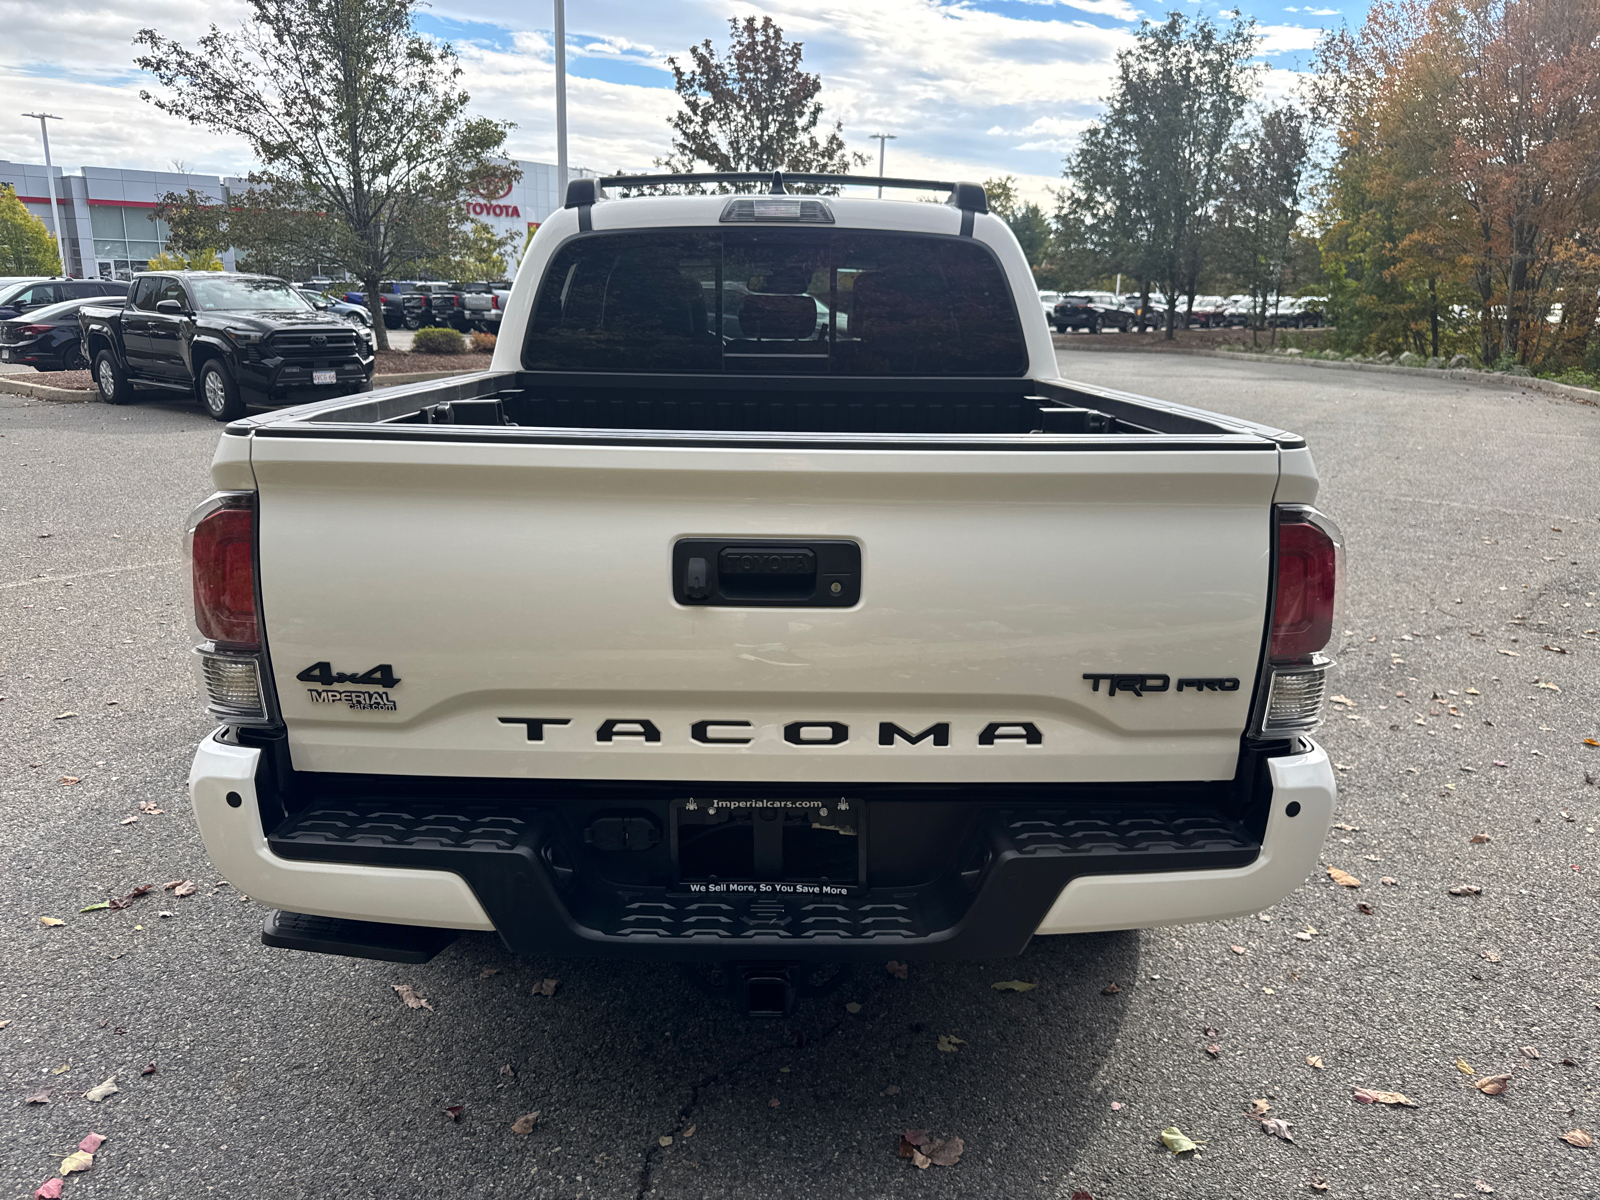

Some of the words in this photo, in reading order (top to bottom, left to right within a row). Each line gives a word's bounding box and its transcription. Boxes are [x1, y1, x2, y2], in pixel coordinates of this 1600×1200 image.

[466, 202, 521, 217] TOYOTA
[726, 555, 809, 571] TOYOTA
[1082, 673, 1170, 697] TRD
[1176, 678, 1240, 692] PRO
[497, 716, 1043, 747] TACOMA
[713, 799, 822, 809] Imperialcars.com
[690, 884, 706, 892] We
[708, 884, 727, 892] Sell
[729, 884, 757, 893] More,
[759, 884, 772, 892] So
[775, 885, 794, 893] You
[796, 885, 820, 894] Save
[823, 886, 847, 895] More
